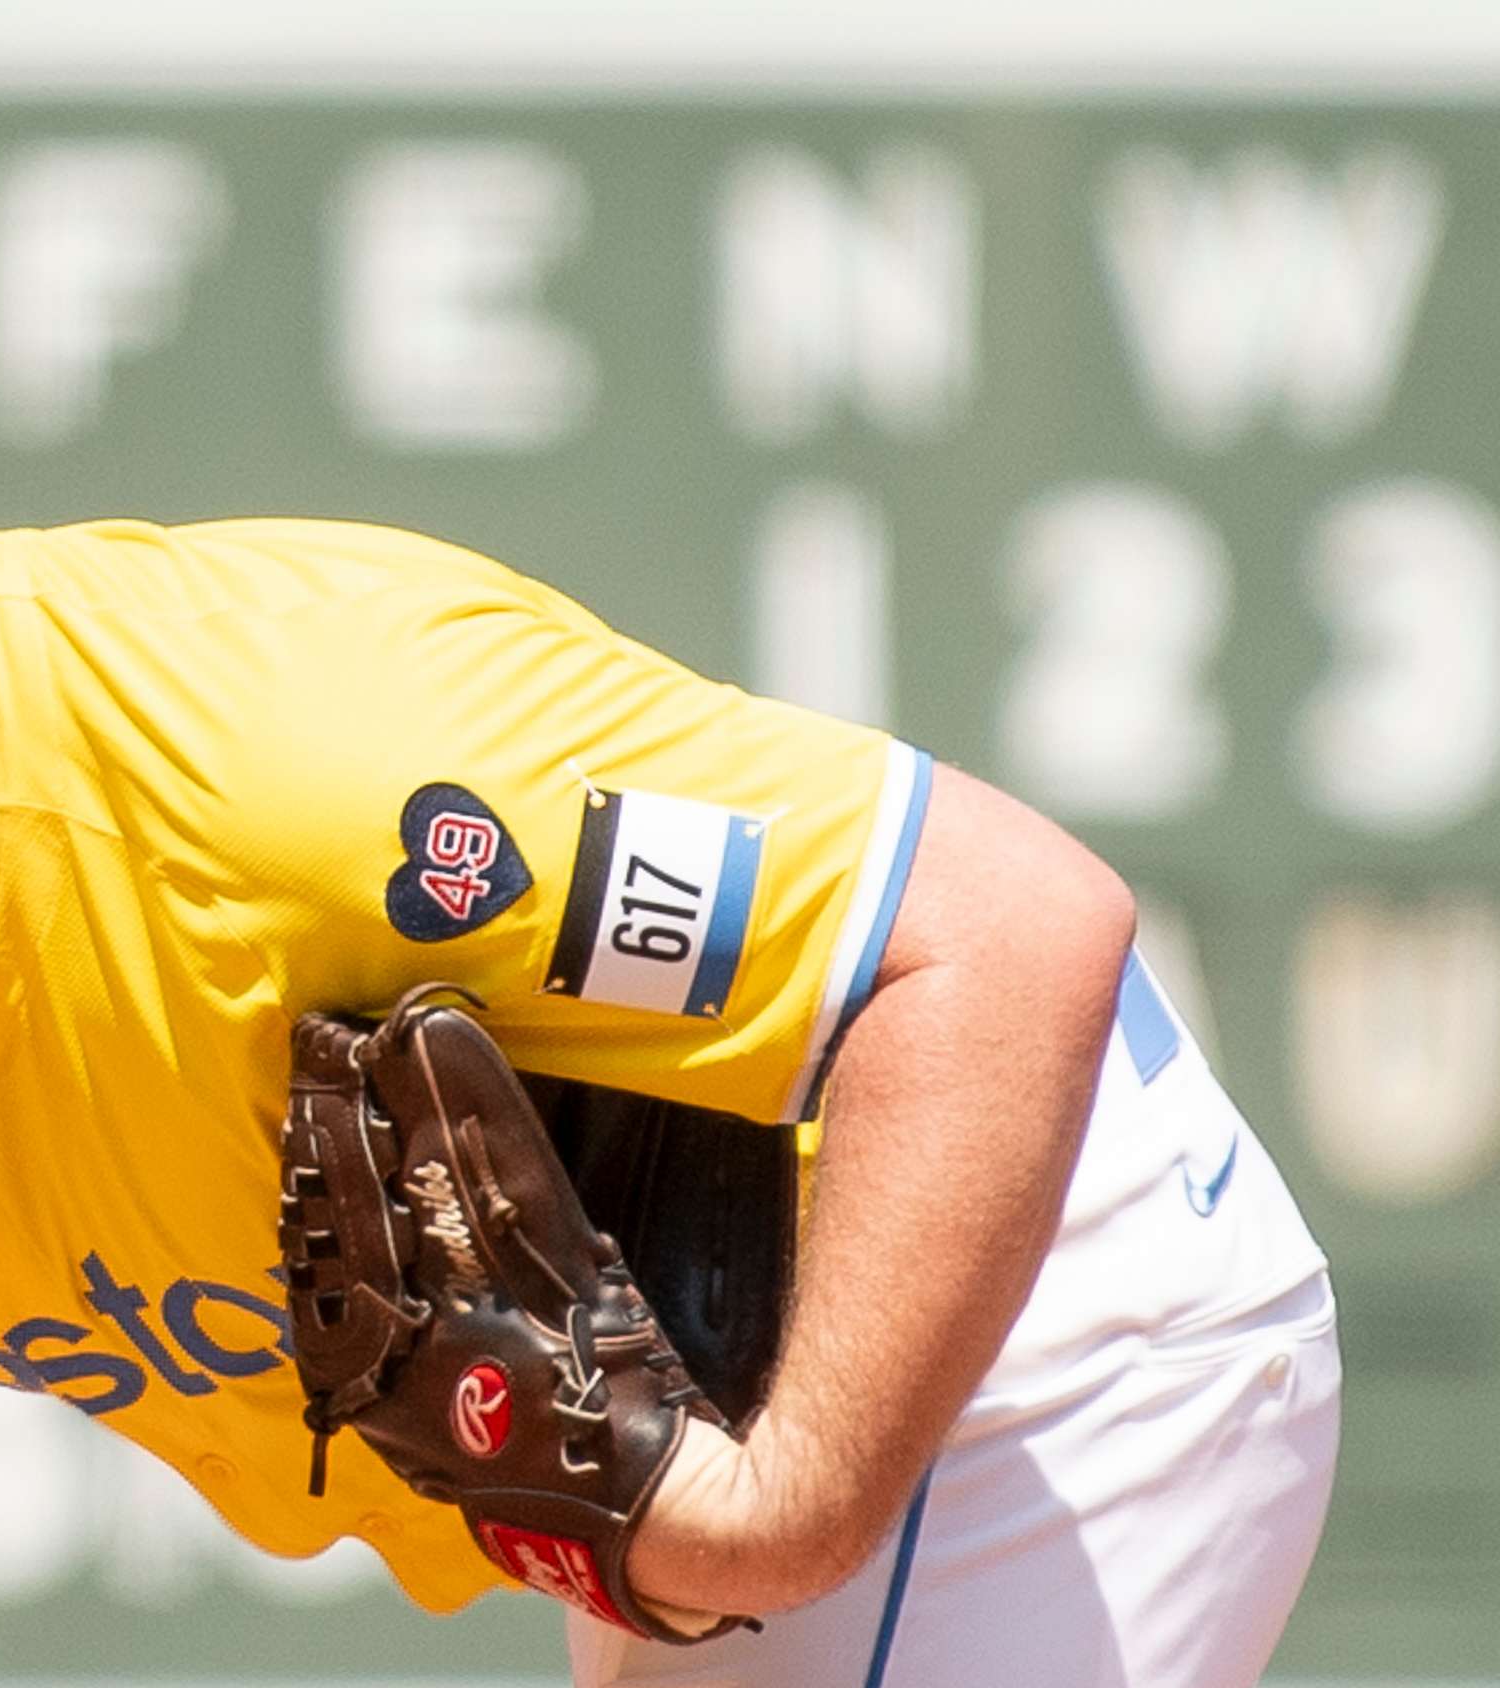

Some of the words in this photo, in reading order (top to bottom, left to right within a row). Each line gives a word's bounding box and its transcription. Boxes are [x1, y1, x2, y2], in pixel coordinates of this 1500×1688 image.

[1010, 485, 1226, 830] 2
[420, 811, 499, 919] 49
[612, 854, 702, 963] 617
[457, 1374, 507, 1454] R
